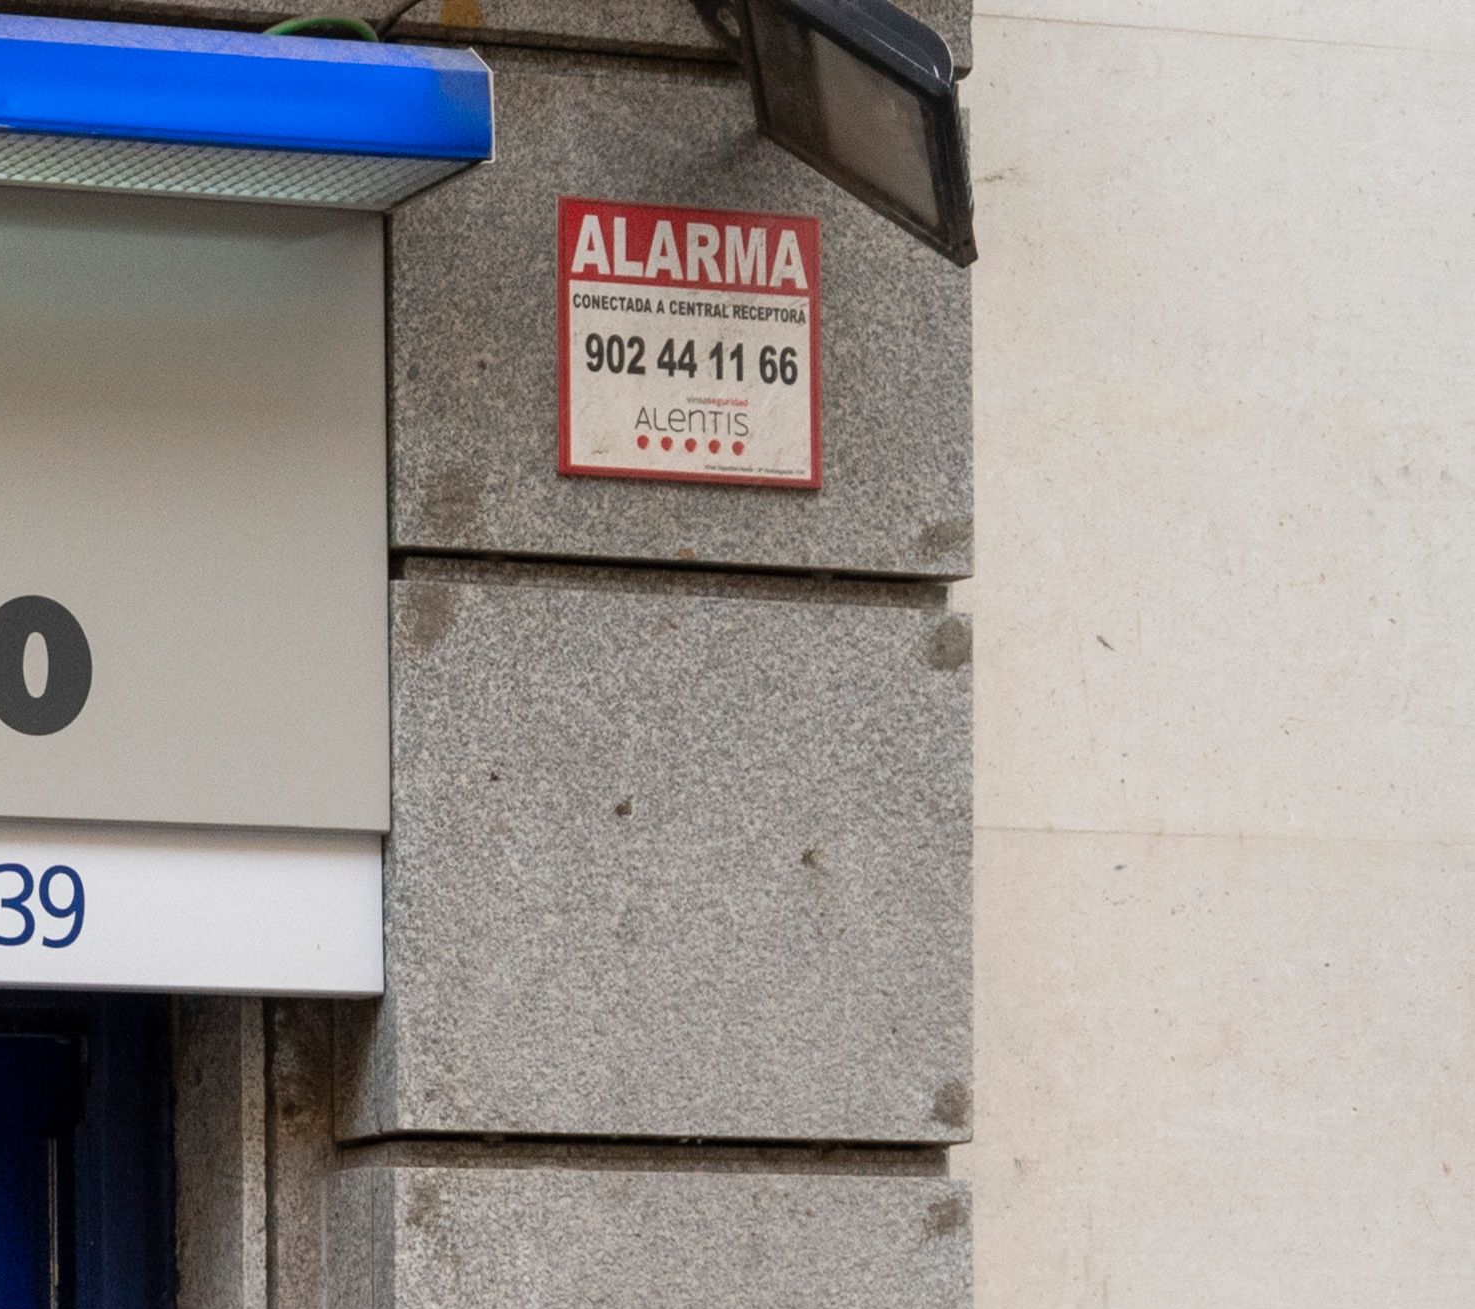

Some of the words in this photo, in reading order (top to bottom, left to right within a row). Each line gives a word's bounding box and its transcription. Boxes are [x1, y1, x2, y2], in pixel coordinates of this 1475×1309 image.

[571, 213, 809, 290] ALARMA
[572, 292, 652, 314] CONECTADA
[655, 298, 665, 315] A
[669, 300, 729, 320] CENTRAL
[732, 305, 806, 325] RECEPTORA
[585, 332, 646, 377] 902
[656, 337, 698, 379] 44
[708, 340, 744, 382] 11
[758, 345, 798, 386] 66
